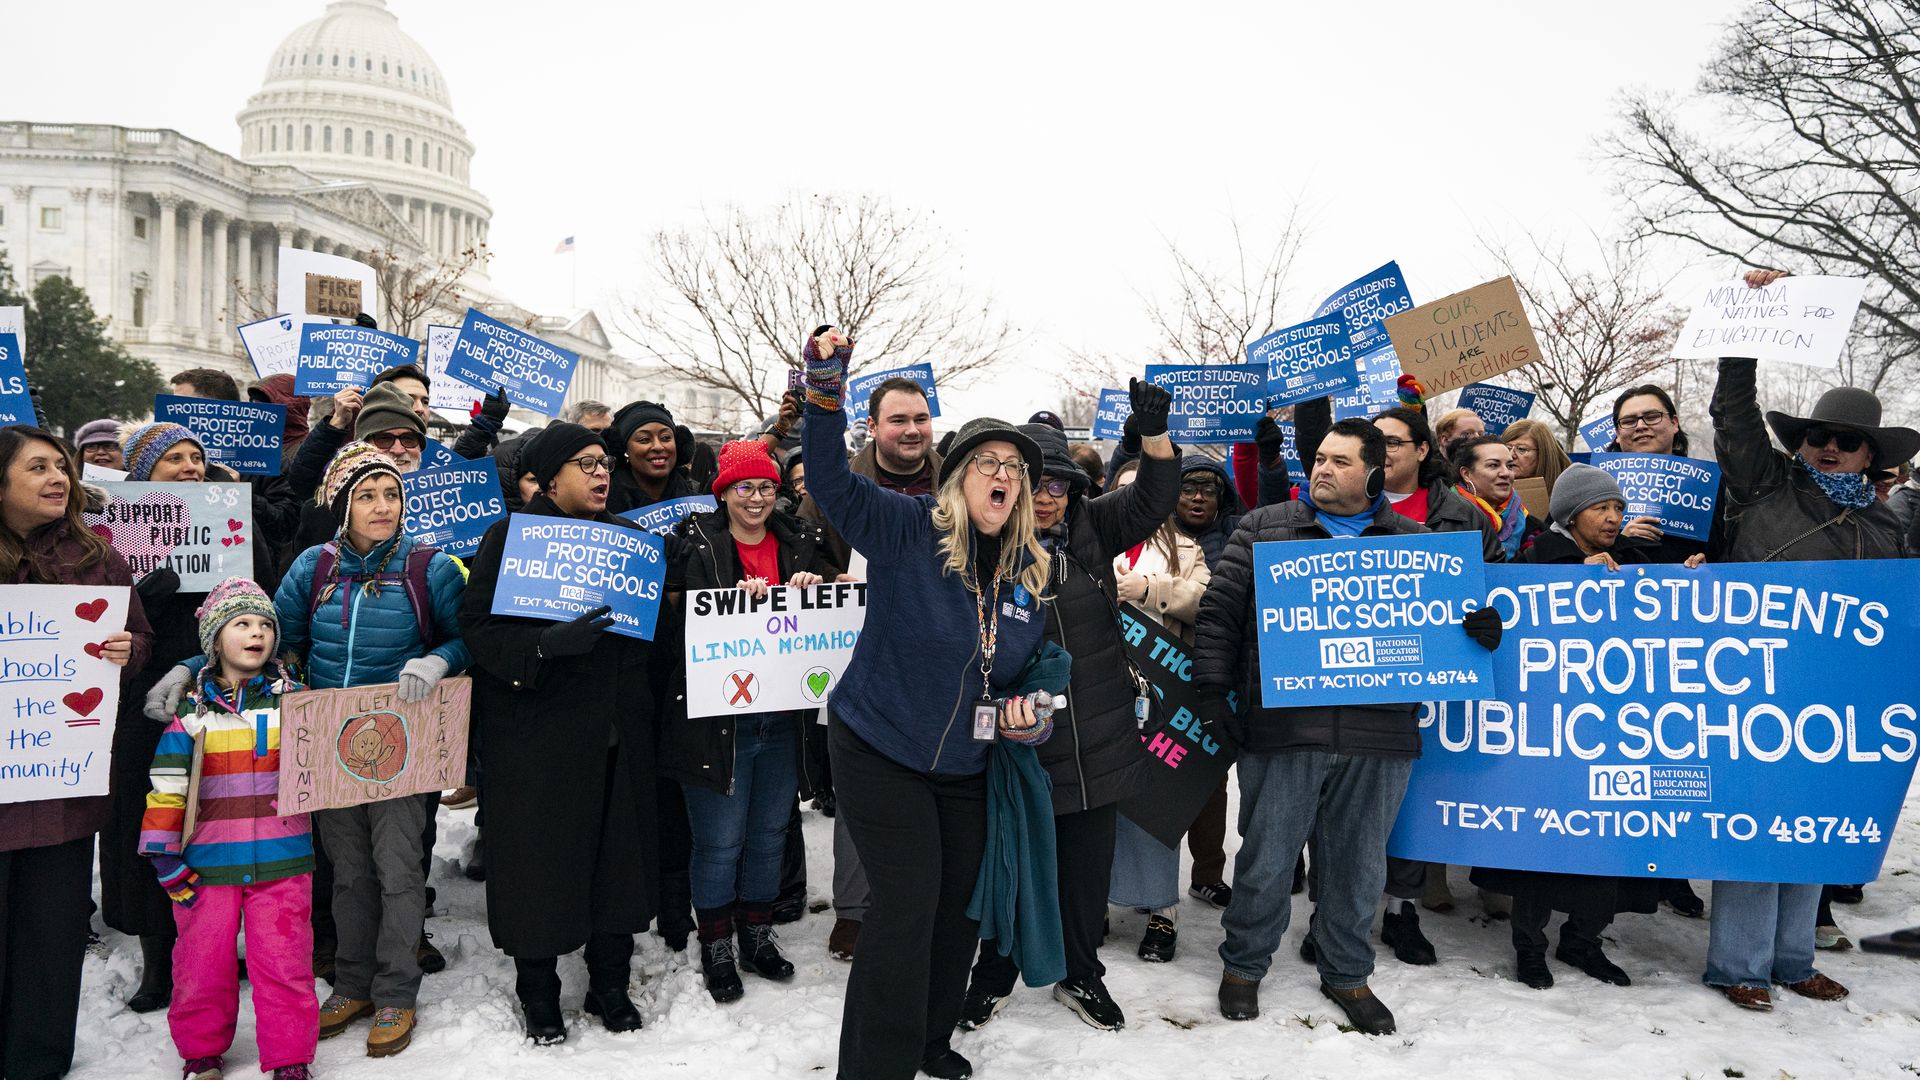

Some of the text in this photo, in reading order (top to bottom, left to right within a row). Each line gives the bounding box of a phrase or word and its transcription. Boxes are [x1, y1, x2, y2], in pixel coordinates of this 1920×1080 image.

[318, 279, 358, 299] FIRE
[1320, 277, 1396, 317] OTECT STUDENTS
[1704, 285, 1788, 308] MONTANA
[1343, 294, 1380, 319] OTECT
[1352, 296, 1409, 330] SCHOOLS
[1433, 296, 1478, 325] OUR
[1721, 304, 1835, 320] NATIVES FOR
[310, 329, 357, 343] PROTECT
[356, 330, 411, 358] STUDENTS
[474, 321, 520, 344] PROTECT
[519, 337, 569, 369] STUDENTS
[1253, 323, 1340, 360] PROTECT STUDENTS
[1376, 333, 1386, 342] TO
[1414, 310, 1519, 364] STUDENTS
[1692, 324, 1814, 349] EDUCATION
[256, 340, 298, 362] PROTE
[326, 342, 388, 362] PROTECT
[486, 338, 546, 371] PROTECT
[1268, 338, 1322, 366] PROTECT
[1372, 350, 1397, 365] PROT
[1458, 346, 1485, 364] ARE
[300, 354, 394, 376] PUBLIC SCHO
[457, 339, 503, 370] PUBLIC
[503, 362, 566, 393] SCHOOLS
[1267, 363, 1290, 382] LIC
[1290, 346, 1351, 374] SCHOOLS
[1426, 345, 1529, 392] WATCHING
[307, 381, 326, 389] TEXT
[460, 367, 480, 381] TEXT
[513, 391, 524, 400] TO
[855, 373, 888, 392] PROTECT
[1154, 370, 1260, 386] PROTECT STUDENTS
[1313, 382, 1325, 391] TO
[1105, 394, 1130, 403] PROTEC
[1173, 385, 1237, 400] PROTECT
[1336, 395, 1371, 408] PUBLIC
[1466, 388, 1528, 407] PROTECT STUDENTS
[166, 404, 278, 423] PROTECT STUDENTS
[1098, 410, 1125, 422] PUBLIC
[1197, 399, 1264, 415] SCHOOLS
[1473, 397, 1513, 413] PROTECT
[188, 416, 254, 433] PROTECT
[1178, 429, 1213, 437] "ACTION"
[1228, 428, 1252, 436] 48744
[1190, 418, 1205, 426] nea
[1588, 417, 1613, 438] PROTE
[212, 433, 279, 449] SCHOOLS
[418, 471, 488, 489] STUDENTS
[1599, 458, 1711, 483] PROTECT STUDENTS
[1617, 472, 1685, 489] PROTECT
[1638, 487, 1711, 511] SCHOOLS
[106, 503, 183, 524] SUPPORT
[419, 498, 502, 530] SCHOOLS
[635, 506, 677, 531] OTECT
[150, 526, 211, 547] PUBLIC
[1669, 521, 1694, 531] 48744
[450, 540, 465, 550] TO
[467, 537, 484, 546] 487
[521, 524, 589, 541] PROTECT
[591, 529, 660, 564] STUDENTS
[128, 554, 210, 575] DUCATION
[546, 541, 631, 572] PROTECT
[1269, 550, 1464, 584] PROTECT STUDENTS
[503, 558, 573, 582] PUBLIC
[574, 565, 659, 601] SCHOOLS
[1311, 573, 1425, 603] PROTECT
[561, 587, 582, 599] nea
[694, 583, 867, 616] SWIPE LEFT
[513, 596, 542, 607] TEXT
[543, 599, 593, 614] "ACTION"
[610, 611, 639, 627] 48744
[1262, 599, 1478, 633] PUBLIC SCHOOLS
[1485, 578, 1889, 647] OTECT STUDENTS
[0, 611, 60, 635] blic
[766, 615, 798, 634] ON
[692, 638, 766, 663] LINDA
[1324, 639, 1419, 665] nea NATIONAL
[1376, 647, 1419, 655] EDUCATION
[1377, 655, 1420, 663] ASSOCIATION
[0, 653, 77, 680] hools
[1518, 637, 1789, 695] PROTECT
[1273, 669, 1478, 691] TEXT "ACTION" TO 48744
[13, 696, 57, 719] the
[359, 694, 392, 713] LET
[6, 728, 52, 750] the
[436, 686, 450, 783] LEARN
[1617, 702, 1919, 764] SCHOOLS
[295, 700, 313, 810] TRUMP
[1140, 731, 1189, 769] HE
[0, 751, 94, 786] munity!
[365, 782, 393, 799] US
[1594, 770, 1706, 796] nea NATIONAL
[1654, 780, 1706, 788] EDUCATION
[1654, 789, 1707, 797] ASSOCIATION
[1436, 800, 1882, 845] TEXT "ACTION" TO 48744
